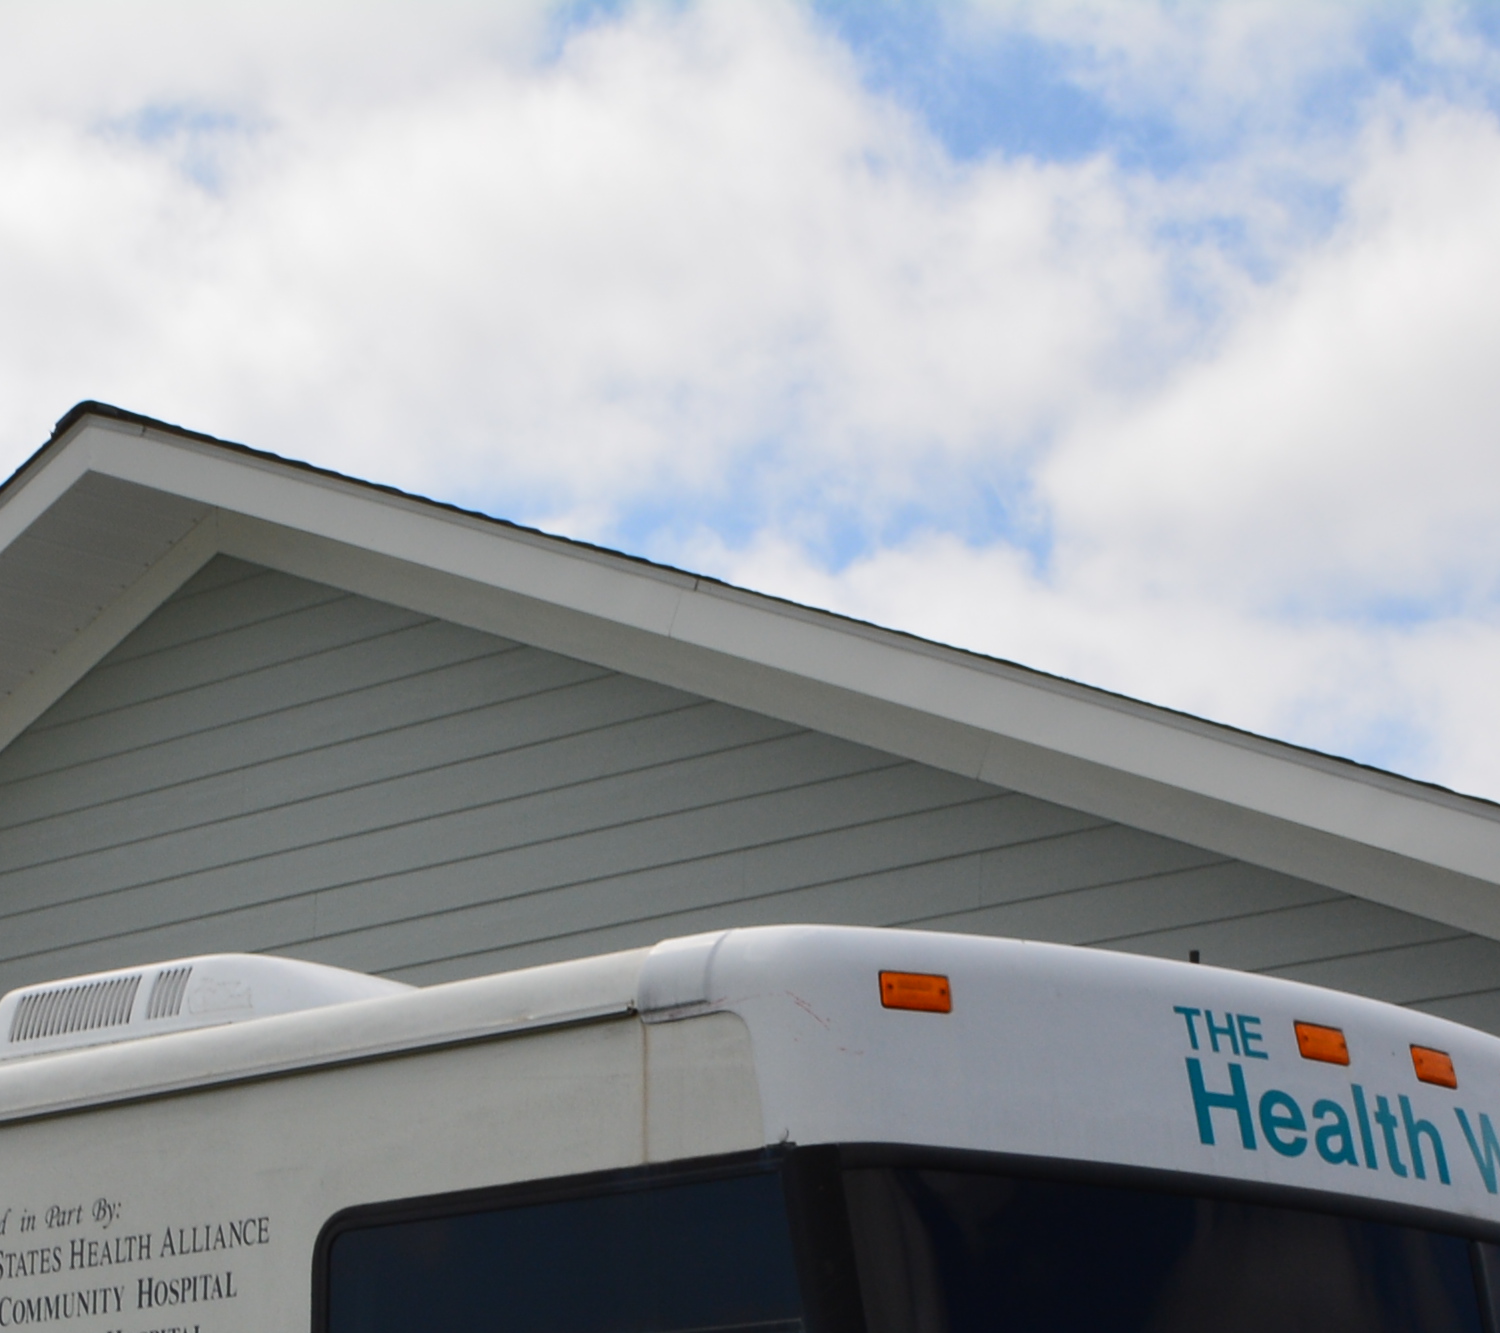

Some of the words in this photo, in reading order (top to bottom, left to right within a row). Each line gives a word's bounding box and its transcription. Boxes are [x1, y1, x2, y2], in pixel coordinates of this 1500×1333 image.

[1173, 1005, 1269, 1061] THE
[1185, 1056, 1451, 1186] Health
[21, 1211, 36, 1232] in
[45, 1203, 83, 1230] Part
[92, 1197, 122, 1228] By:
[69, 1233, 152, 1271] HEALTH
[160, 1216, 270, 1259] ALLIANCE
[137, 1271, 238, 1310] HOSPITAL
